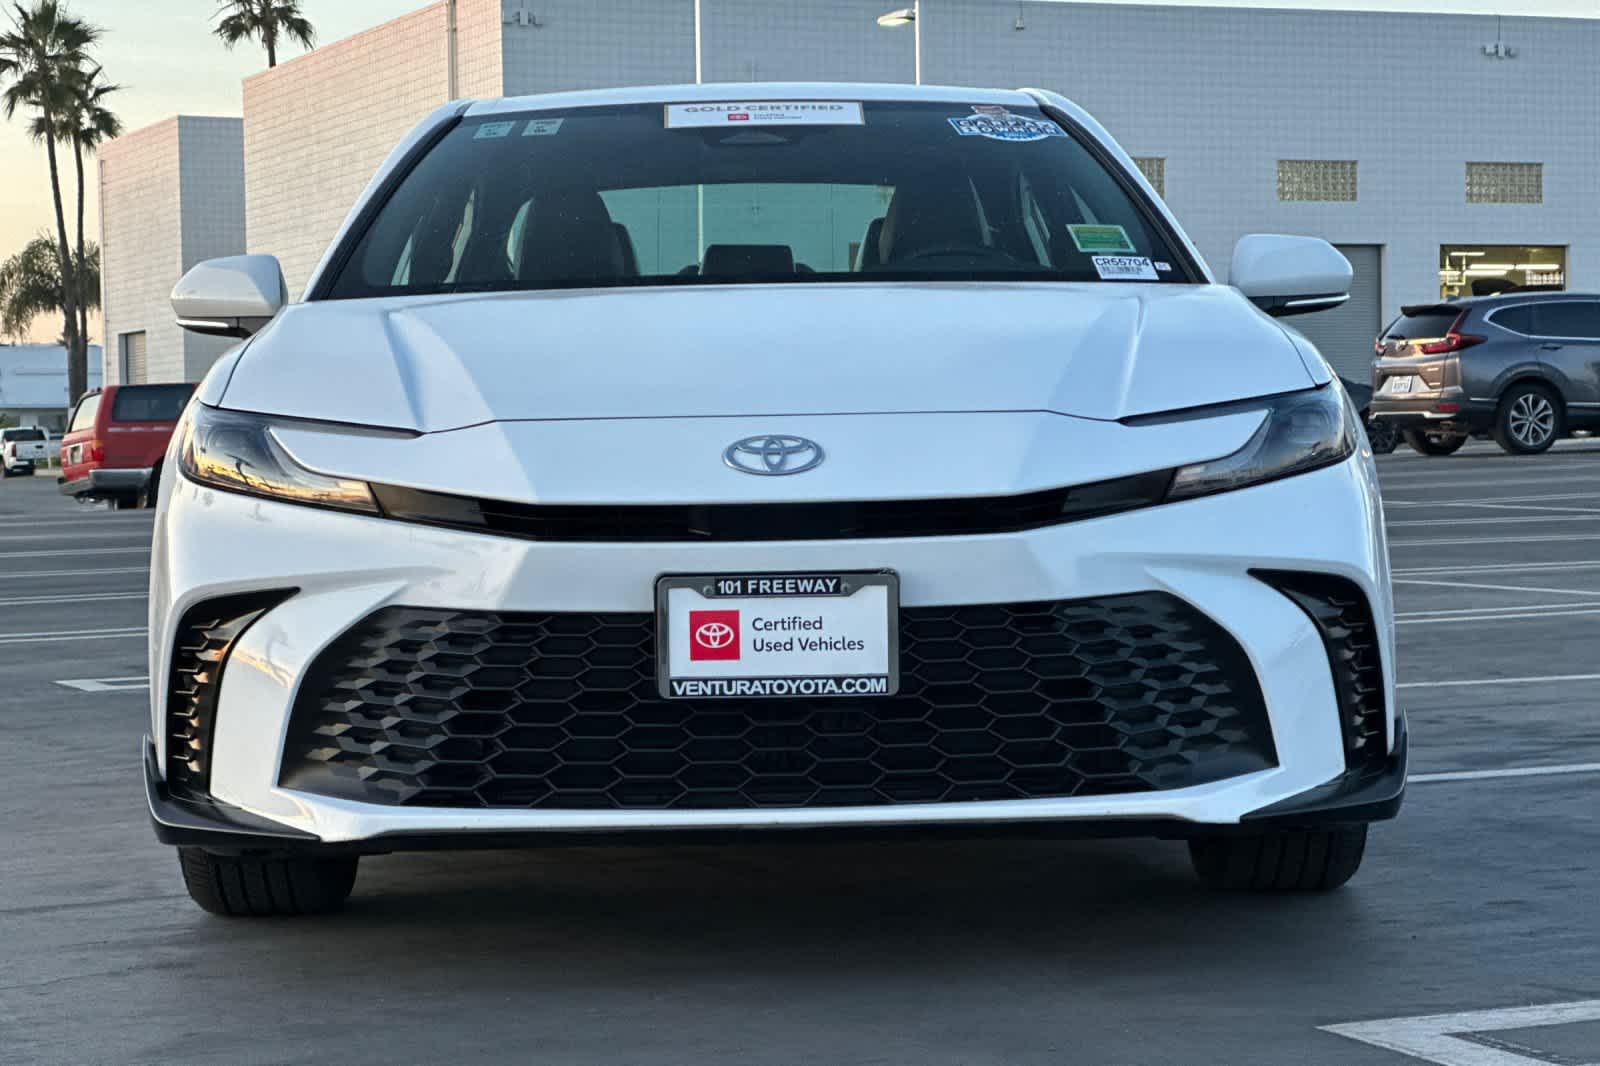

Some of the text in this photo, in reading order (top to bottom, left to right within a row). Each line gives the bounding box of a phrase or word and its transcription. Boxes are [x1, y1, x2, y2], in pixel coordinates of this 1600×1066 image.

[717, 579, 838, 594] 101 FREEWAY
[752, 616, 823, 631] Certified
[752, 636, 865, 652] Used Vehicles
[672, 678, 887, 696] VENTURATOYOTA.COM
